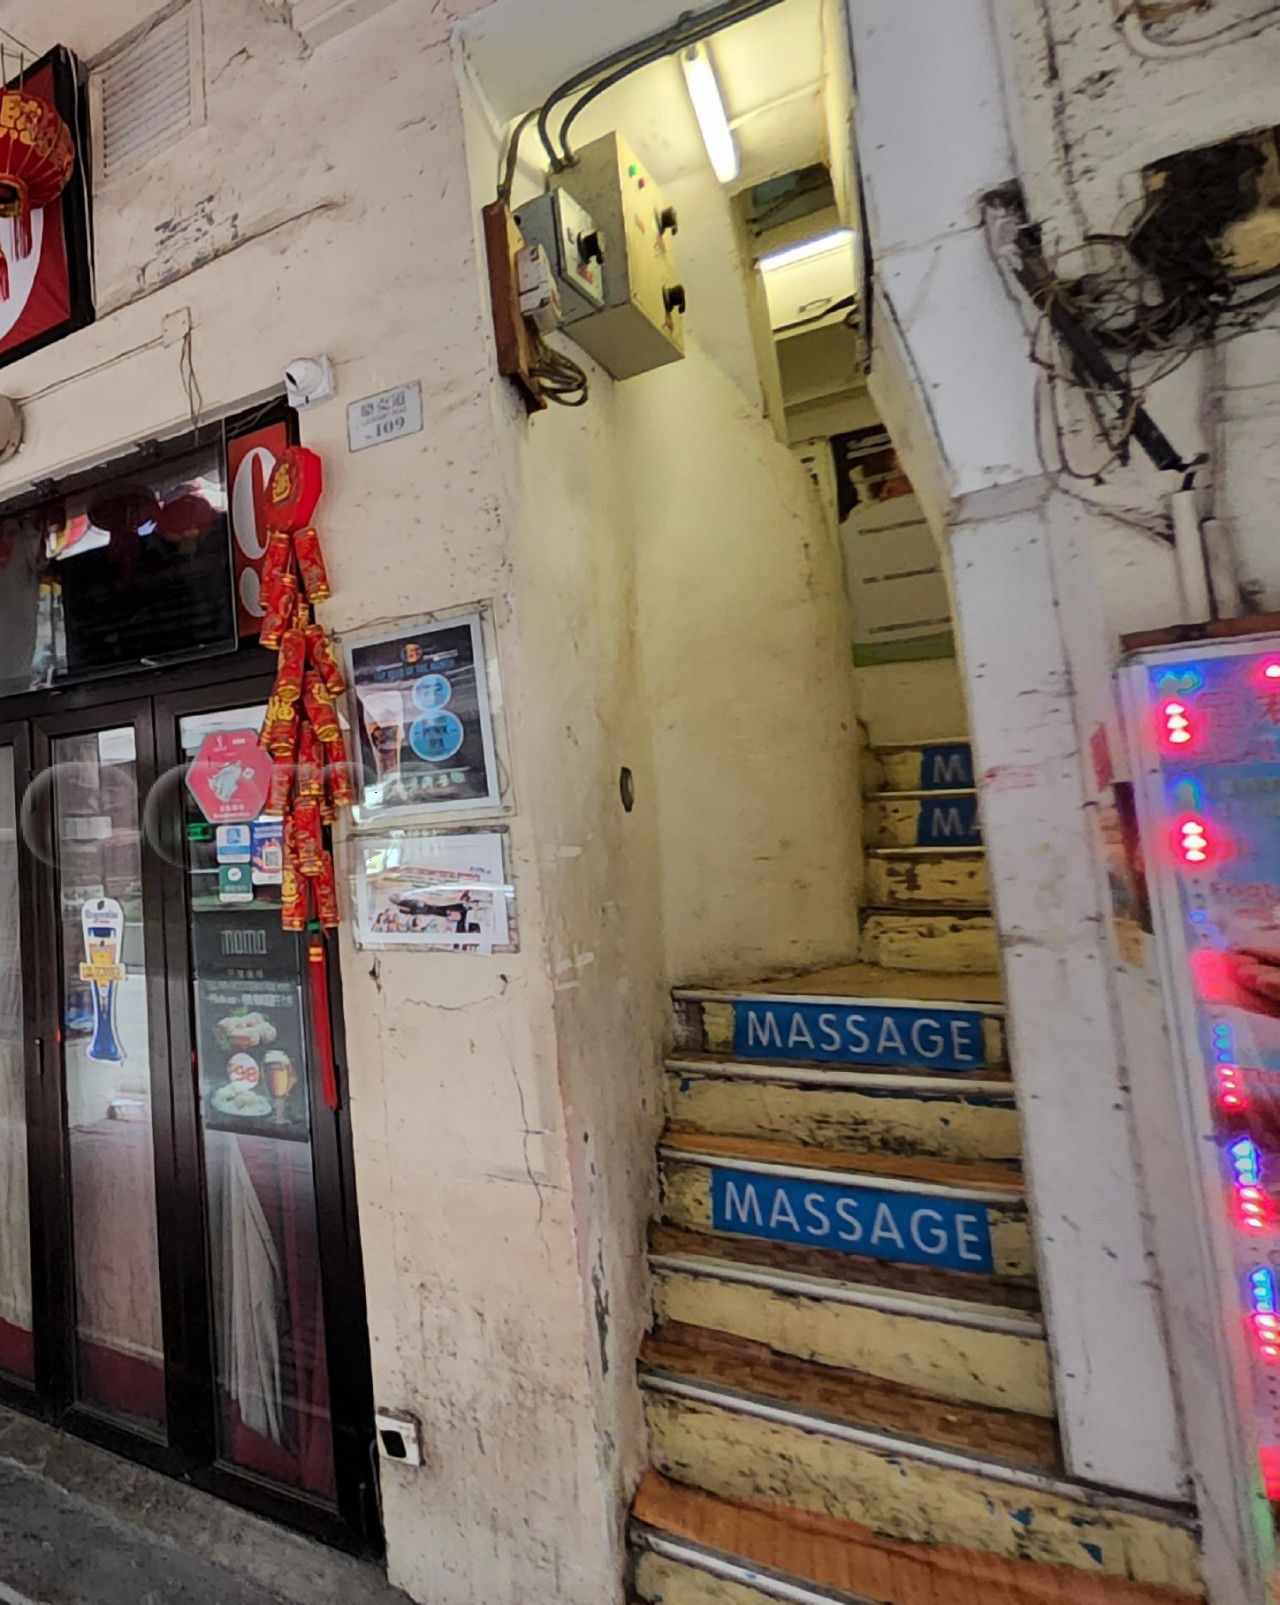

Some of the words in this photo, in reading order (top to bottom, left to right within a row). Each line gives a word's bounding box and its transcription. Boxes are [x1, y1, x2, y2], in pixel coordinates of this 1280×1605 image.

[376, 417, 405, 437] 109
[747, 1011, 974, 1061] MASSAGE
[723, 1181, 983, 1261] MASSAGE
